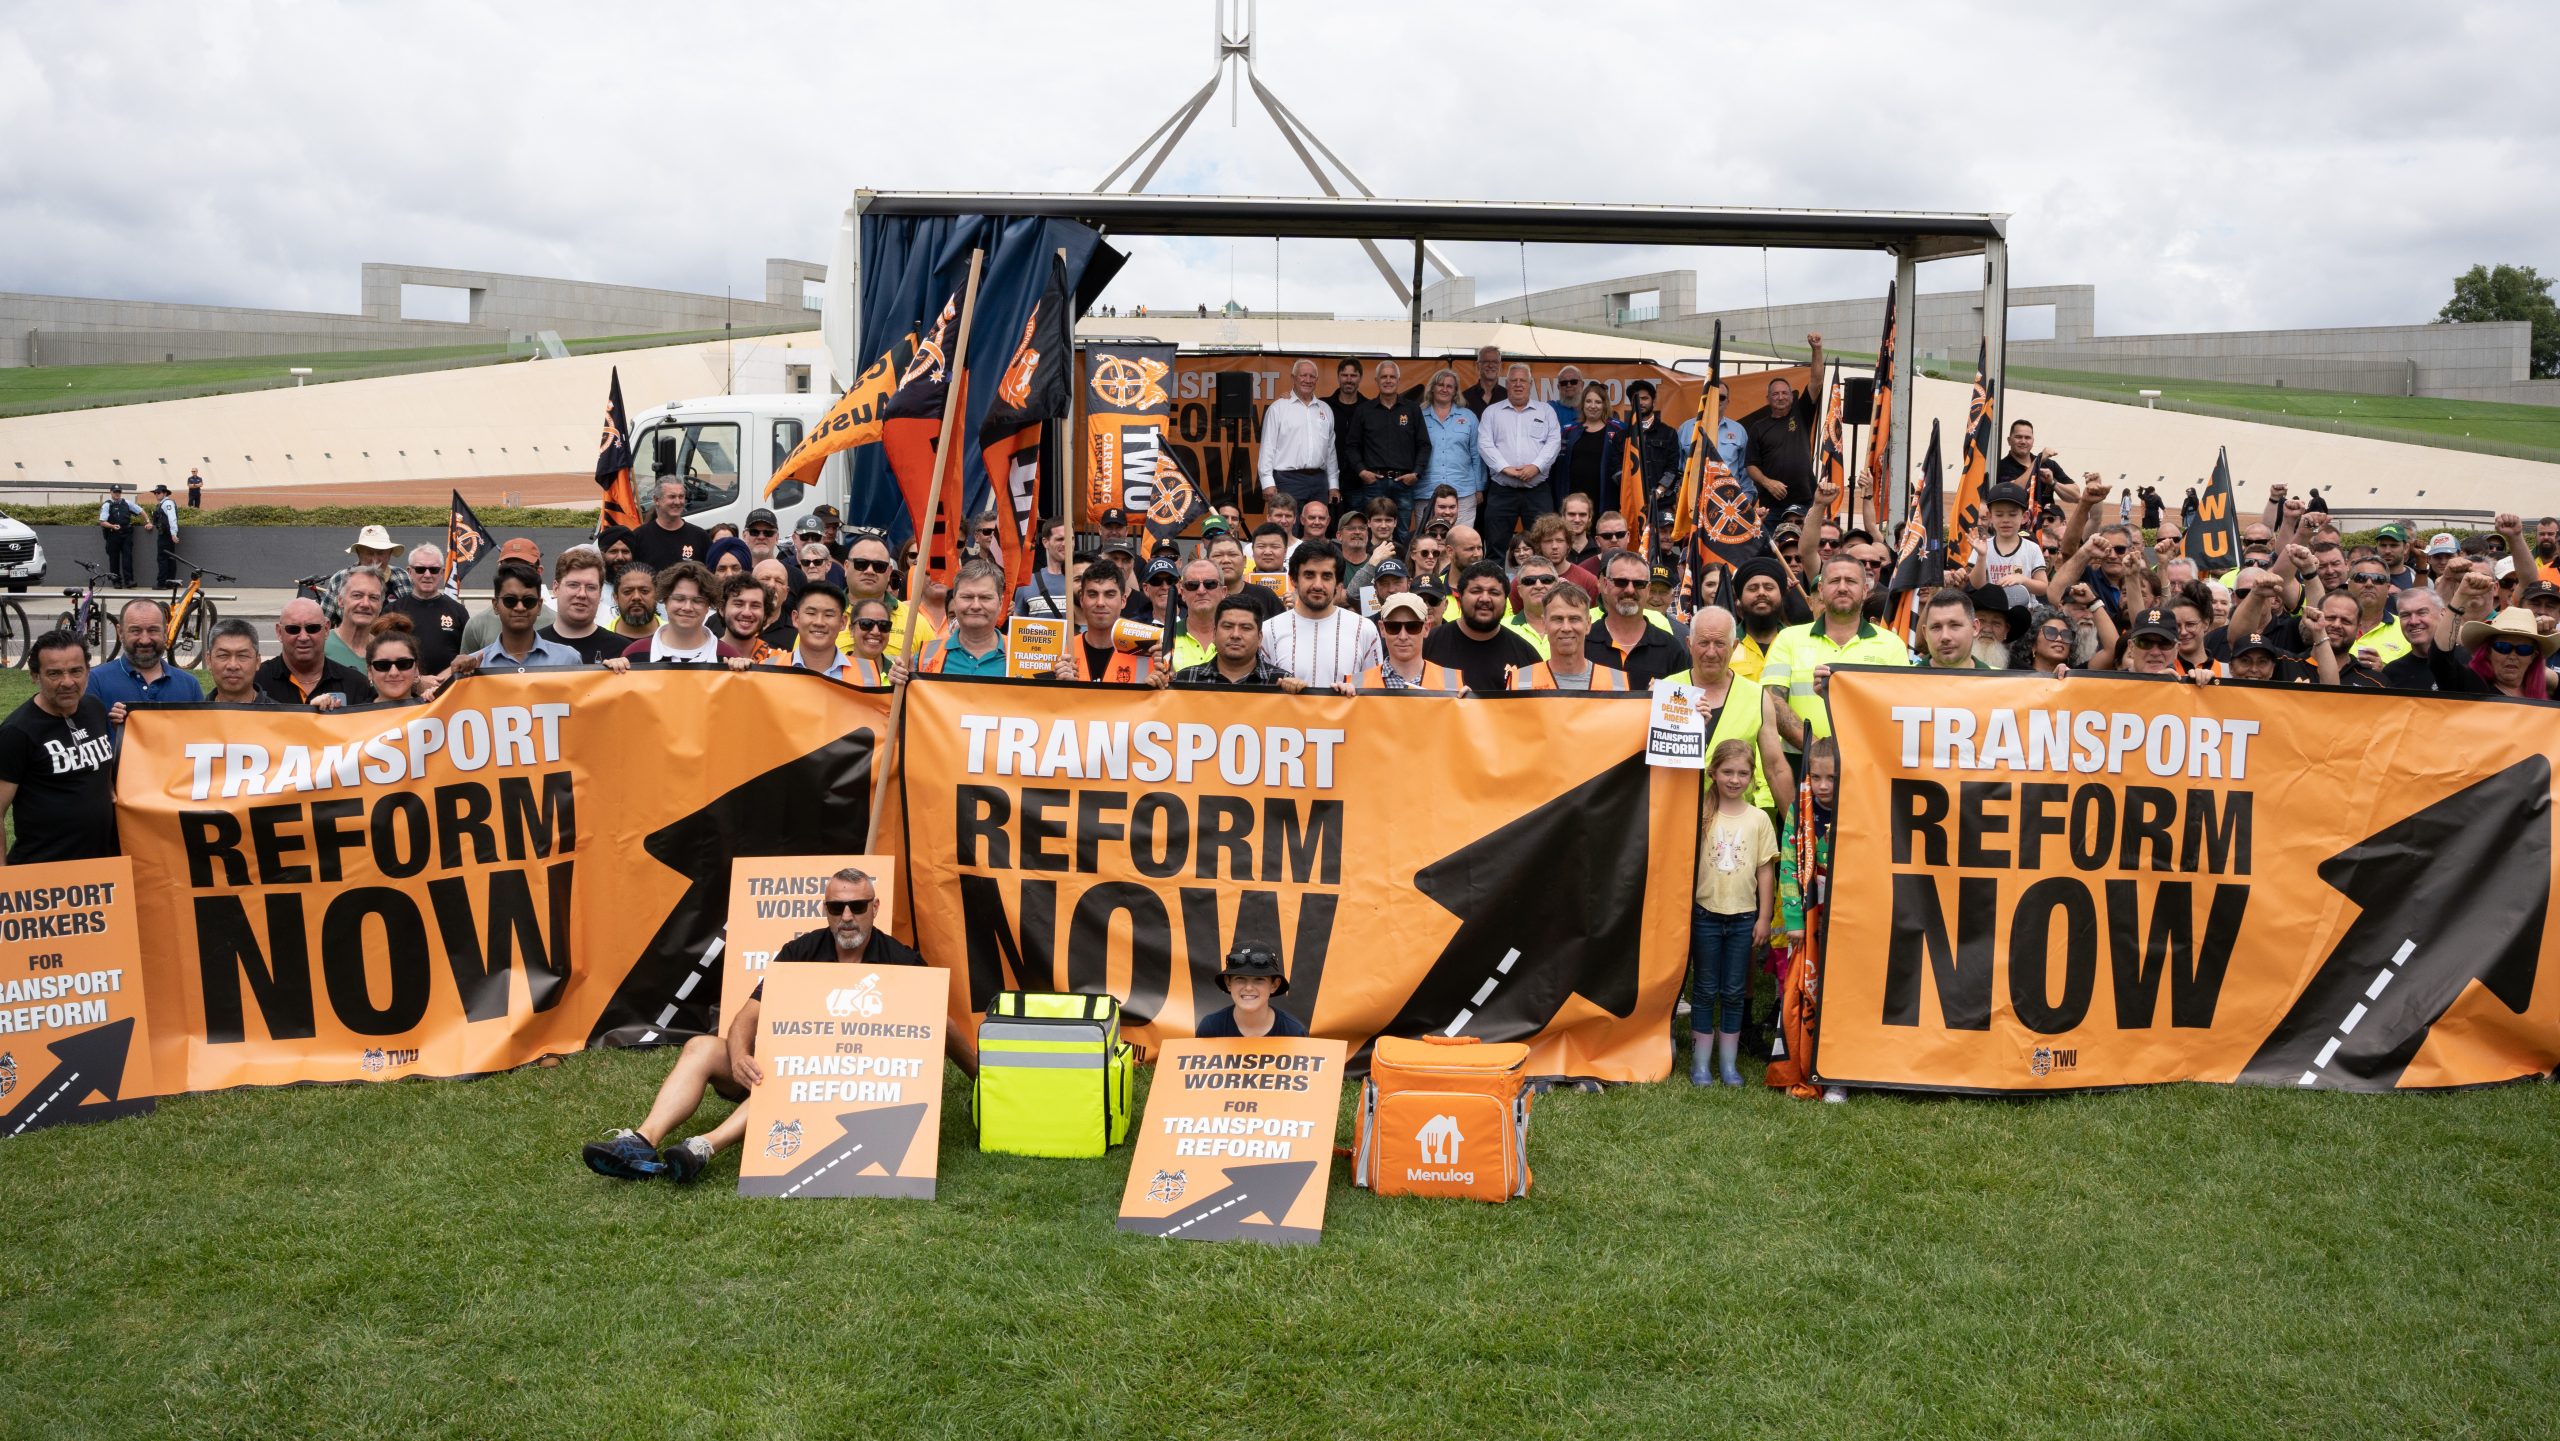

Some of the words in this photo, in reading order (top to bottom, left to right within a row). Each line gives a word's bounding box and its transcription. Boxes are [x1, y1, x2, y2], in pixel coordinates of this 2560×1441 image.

[1102, 433, 1114, 504] CARRYING
[1122, 426, 1161, 512] TWU
[1652, 567, 1669, 578] TWU
[1990, 564, 2012, 573] HAPPY
[1018, 627, 1057, 637] RIDESHARE
[1022, 635, 1052, 645] DRIVERS
[1122, 628, 1153, 640] REFORM
[1014, 652, 1058, 663] TRANSPORT
[1019, 661, 1052, 671] REFORM
[1661, 703, 1693, 716] DELIVERY
[1664, 713, 1689, 724] RIDERS
[71, 728, 89, 741] THE
[1652, 730, 1699, 743] TRANSPORT
[1891, 706, 2261, 780] TRANSPORT
[185, 703, 570, 801] TRANSPORT
[960, 714, 1345, 789] TRANSPORT
[1651, 740, 1699, 755] REFORM
[179, 770, 577, 888] REFORM
[956, 783, 1344, 885] REFORM
[1891, 778, 2254, 876] REFORM
[0, 883, 115, 915] ANSPORT
[756, 899, 828, 919] WORK
[0, 911, 107, 943] ORKERS
[29, 953, 64, 971] FOR
[194, 860, 575, 1045] NOW
[957, 872, 1339, 1036] NOW
[1882, 874, 2250, 1035] NOW
[0, 969, 123, 1004] ANSPORT
[772, 1021, 835, 1036] WASTE
[841, 1022, 932, 1039] WORKERS
[386, 1048, 419, 1065] TWU
[835, 1043, 863, 1054] FOR
[2052, 1049, 2077, 1067] TWU
[774, 1056, 923, 1078] TRANSPORT
[1177, 1054, 1326, 1073] TRANSPORT
[789, 1081, 902, 1103] REFORM
[1184, 1073, 1310, 1092] WORKERS
[1223, 1101, 1259, 1113] FOR
[1163, 1117, 1316, 1138] TRANSPORT
[1176, 1138, 1292, 1160] REFORM
[1407, 1168, 1475, 1185] Menulog
